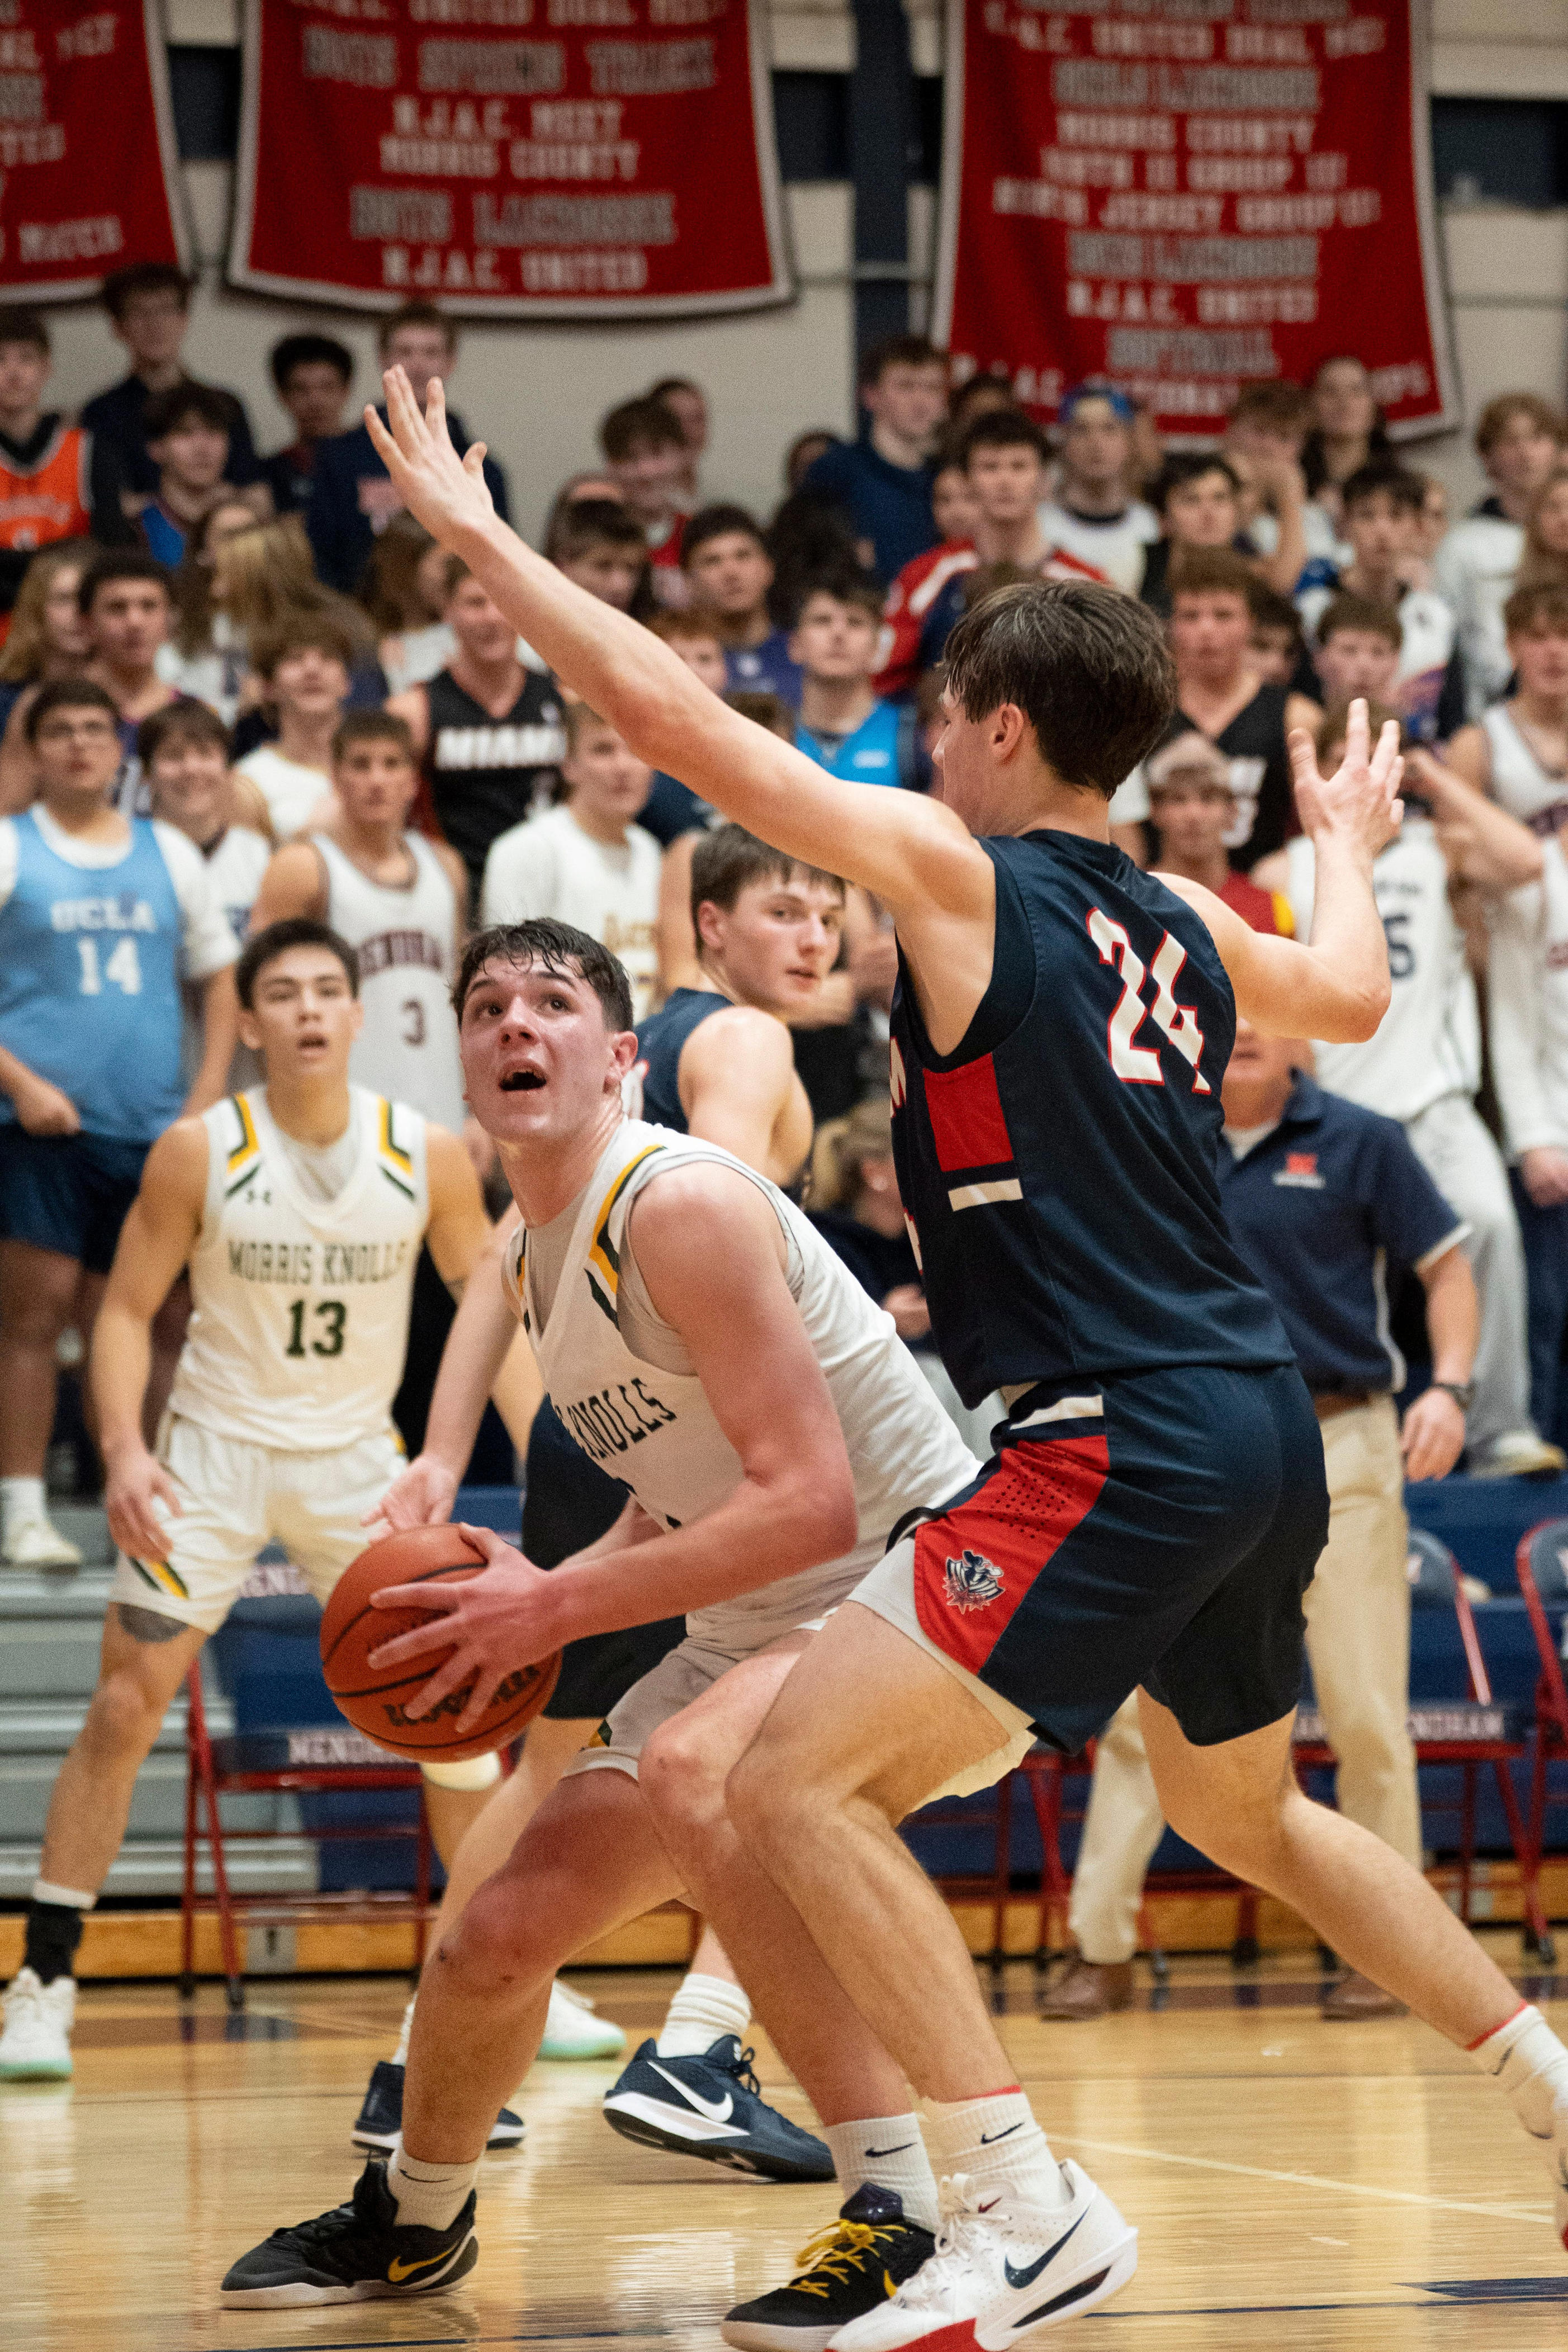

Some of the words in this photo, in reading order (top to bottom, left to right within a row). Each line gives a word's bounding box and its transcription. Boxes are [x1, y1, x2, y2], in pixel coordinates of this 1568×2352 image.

[1057, 113, 1177, 150] MORRIS
[1186, 116, 1315, 154] COUNTY
[380, 139, 499, 178] MORRIS
[510, 141, 639, 179] COUNTY
[435, 726, 567, 770] MIAMI
[51, 898, 157, 933] UCLA
[78, 938, 141, 996] 14
[401, 997, 427, 1047] 3
[1086, 906, 1211, 1095] 24
[228, 1239, 312, 1285] MORRIS
[322, 1239, 406, 1285] KNOLLS
[286, 1299, 348, 1357] 13
[566, 1378, 678, 1460] KNOLLS
